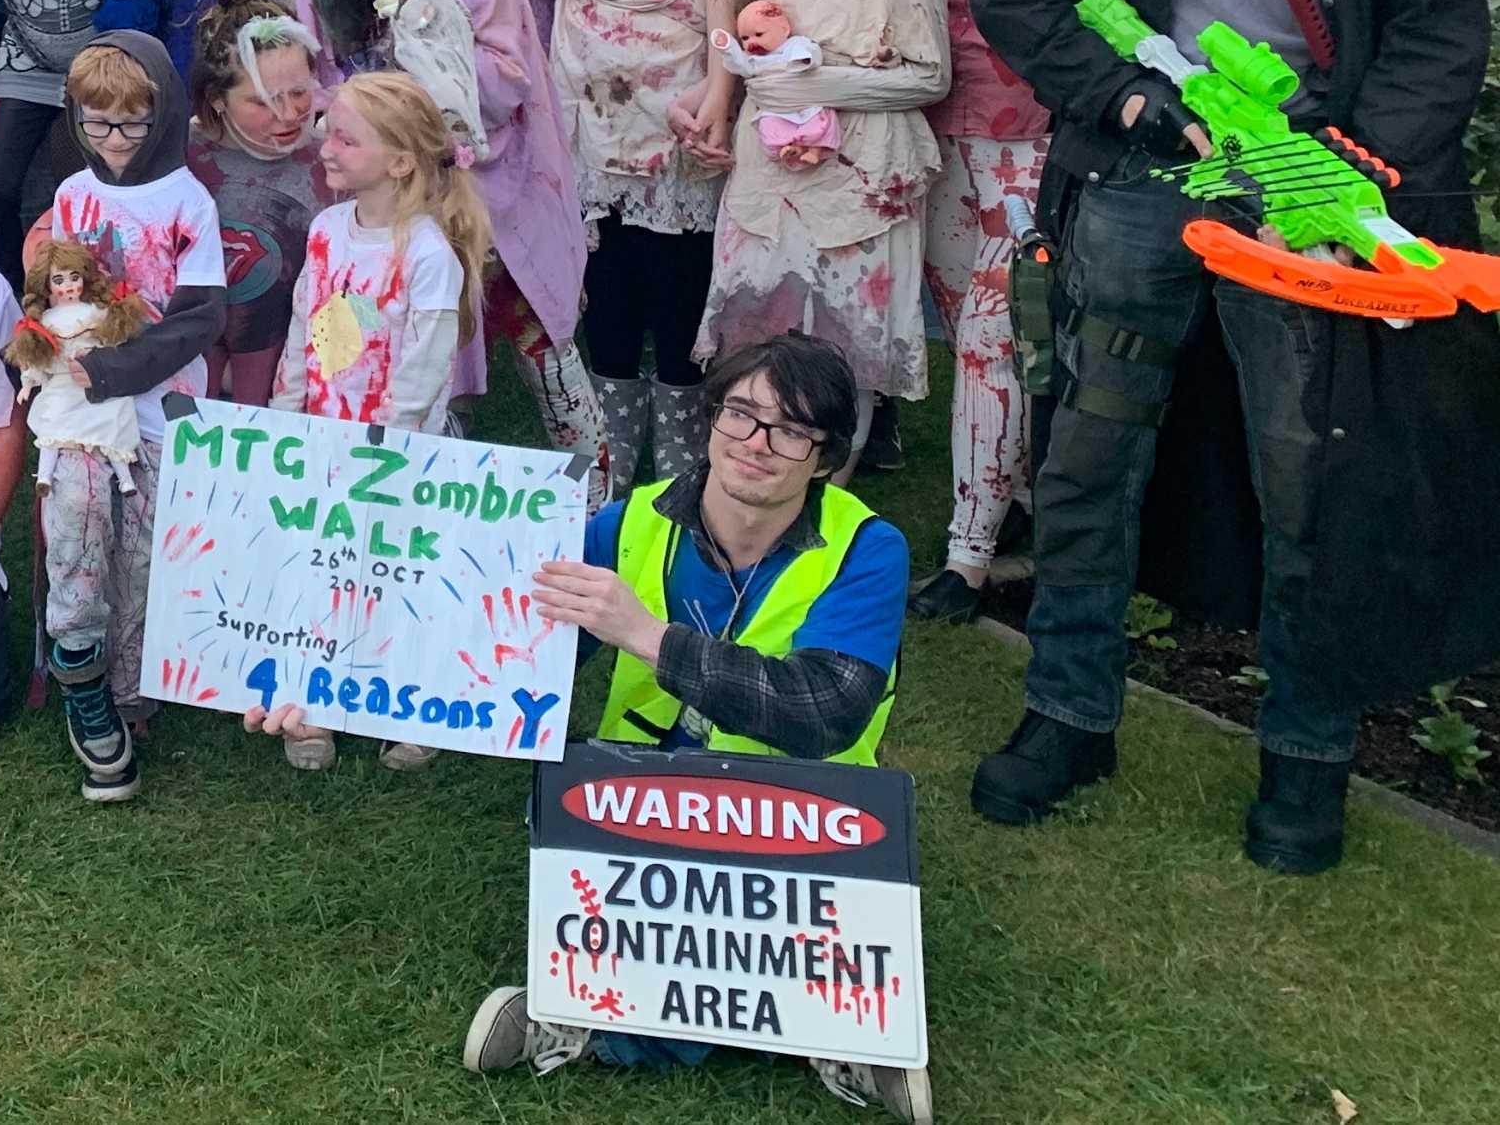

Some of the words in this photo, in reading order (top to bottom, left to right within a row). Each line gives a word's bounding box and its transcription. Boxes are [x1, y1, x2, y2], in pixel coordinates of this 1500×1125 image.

[173, 420, 305, 480] MTG
[348, 445, 559, 524] Zombie
[269, 494, 442, 561] WALK
[310, 546, 357, 571] 26th
[371, 561, 425, 584] OCT
[328, 575, 383, 602] 2019
[246, 657, 278, 713] 4
[306, 666, 497, 731] Reasons
[511, 687, 561, 749] Y
[583, 782, 863, 846] WARNING
[604, 858, 837, 929] ZOMBIE
[555, 913, 892, 988] CONTAINMENT
[660, 979, 784, 1036] AREA
